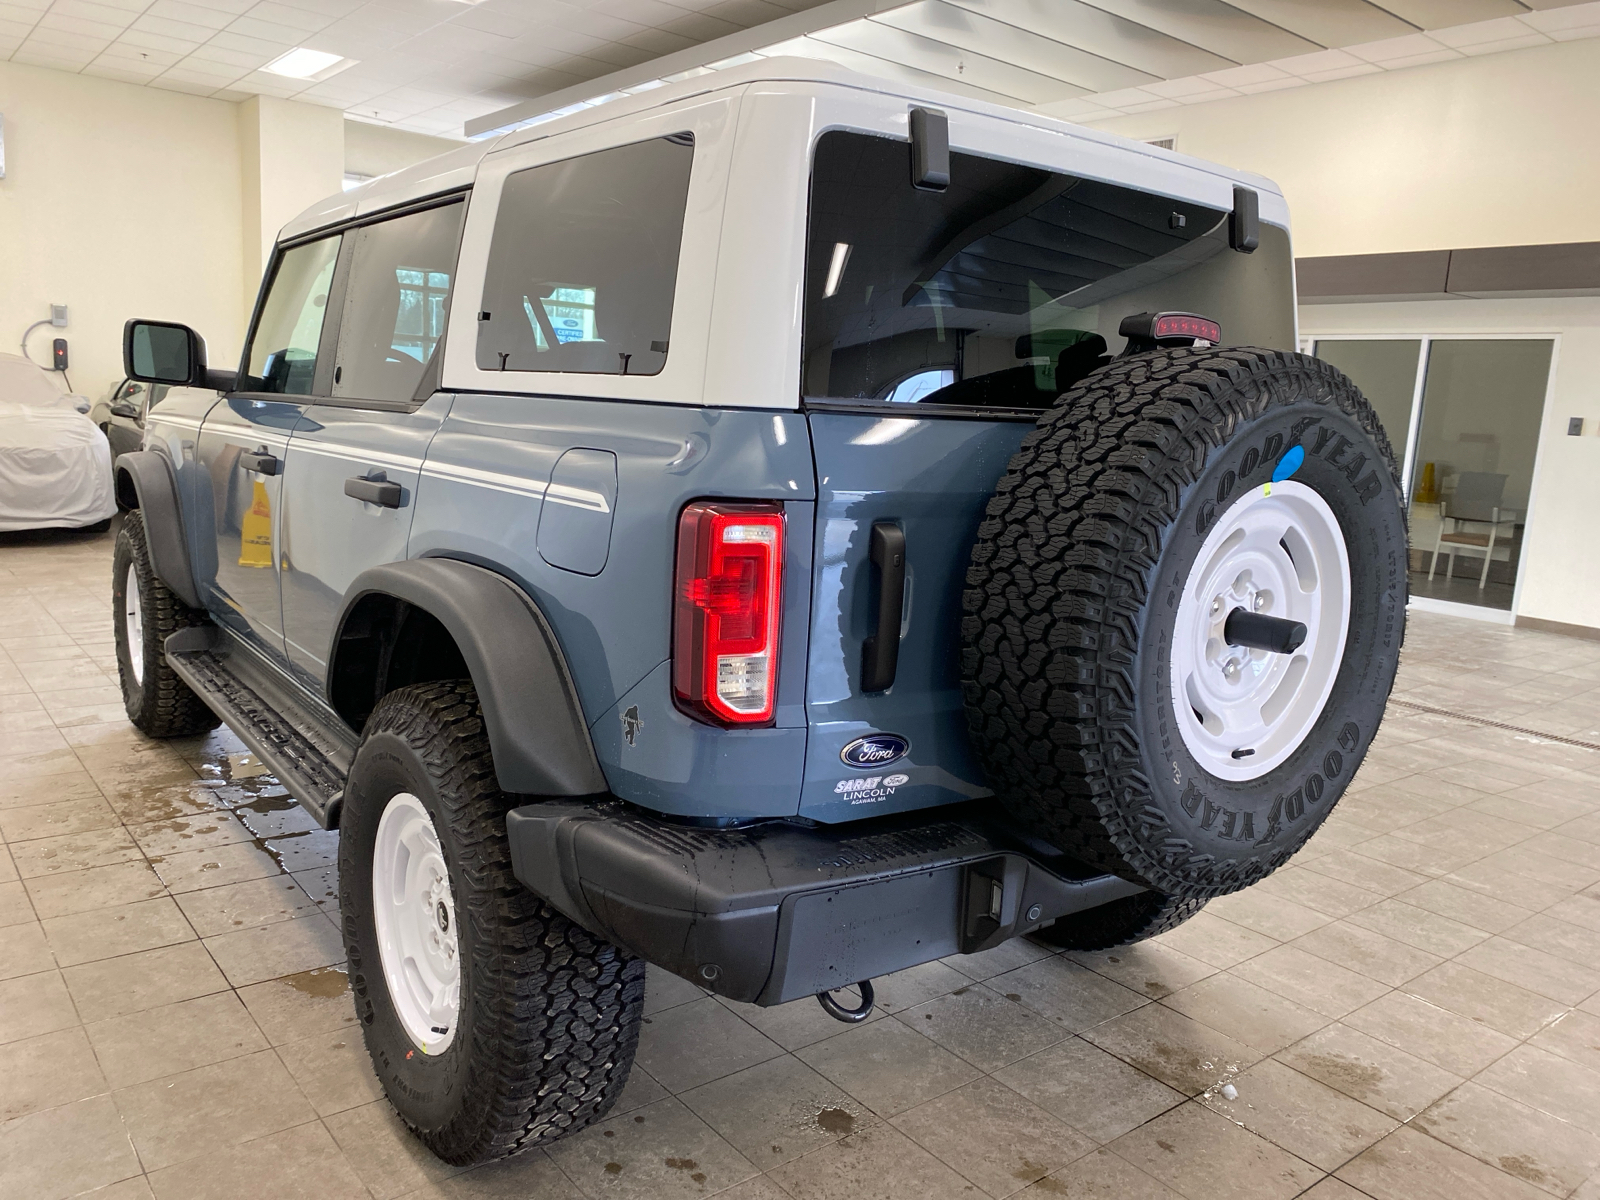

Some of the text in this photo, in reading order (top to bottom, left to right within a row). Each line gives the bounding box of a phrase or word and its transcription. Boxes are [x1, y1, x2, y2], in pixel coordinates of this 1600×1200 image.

[858, 741, 895, 762] Ford
[834, 776, 883, 793] SARAT
[843, 787, 896, 800] LINCOLN
